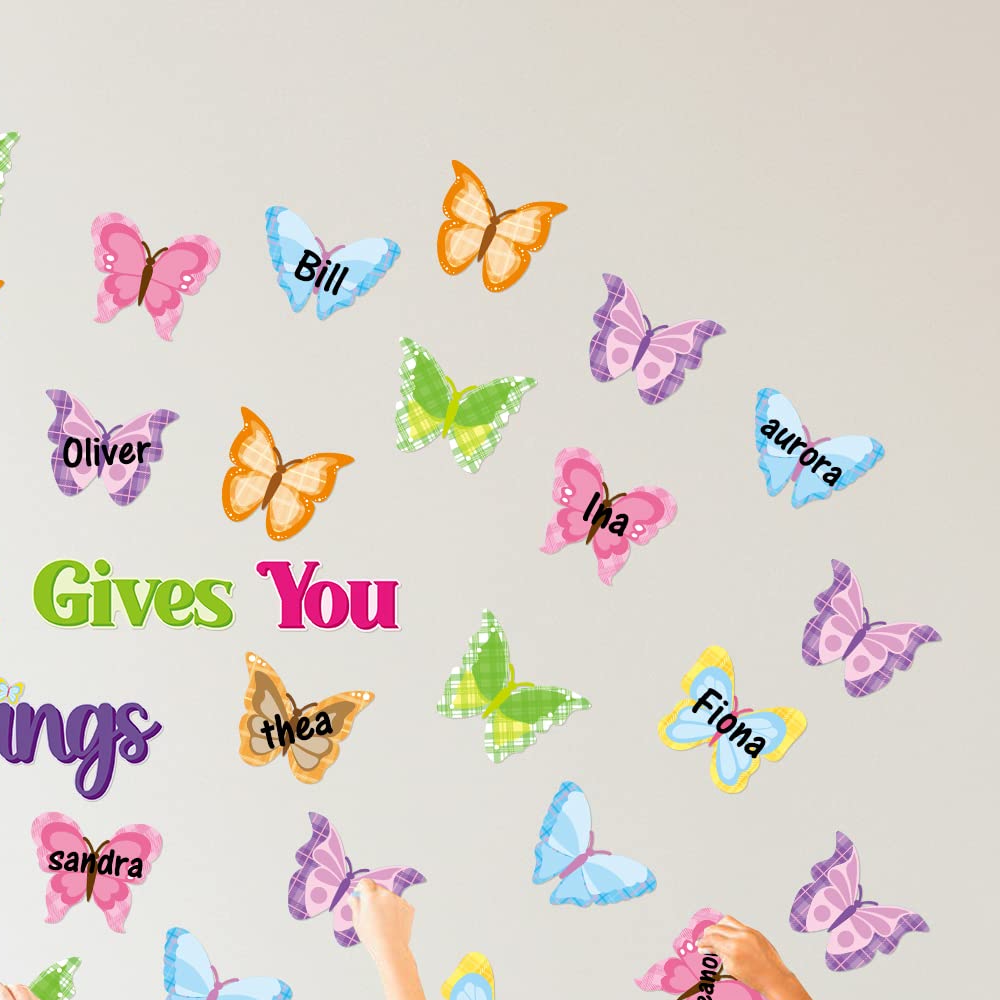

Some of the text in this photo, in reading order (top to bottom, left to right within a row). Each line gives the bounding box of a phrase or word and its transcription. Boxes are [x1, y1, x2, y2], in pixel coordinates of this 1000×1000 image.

[294, 249, 349, 296] Bill
[63, 436, 152, 468] Oliver
[758, 418, 842, 487] aurora
[582, 491, 630, 537] Ina
[34, 560, 232, 628] Gives
[256, 562, 398, 630] You
[260, 711, 337, 749] thea
[692, 688, 766, 759] Fiona
[48, 849, 144, 881] sandra
